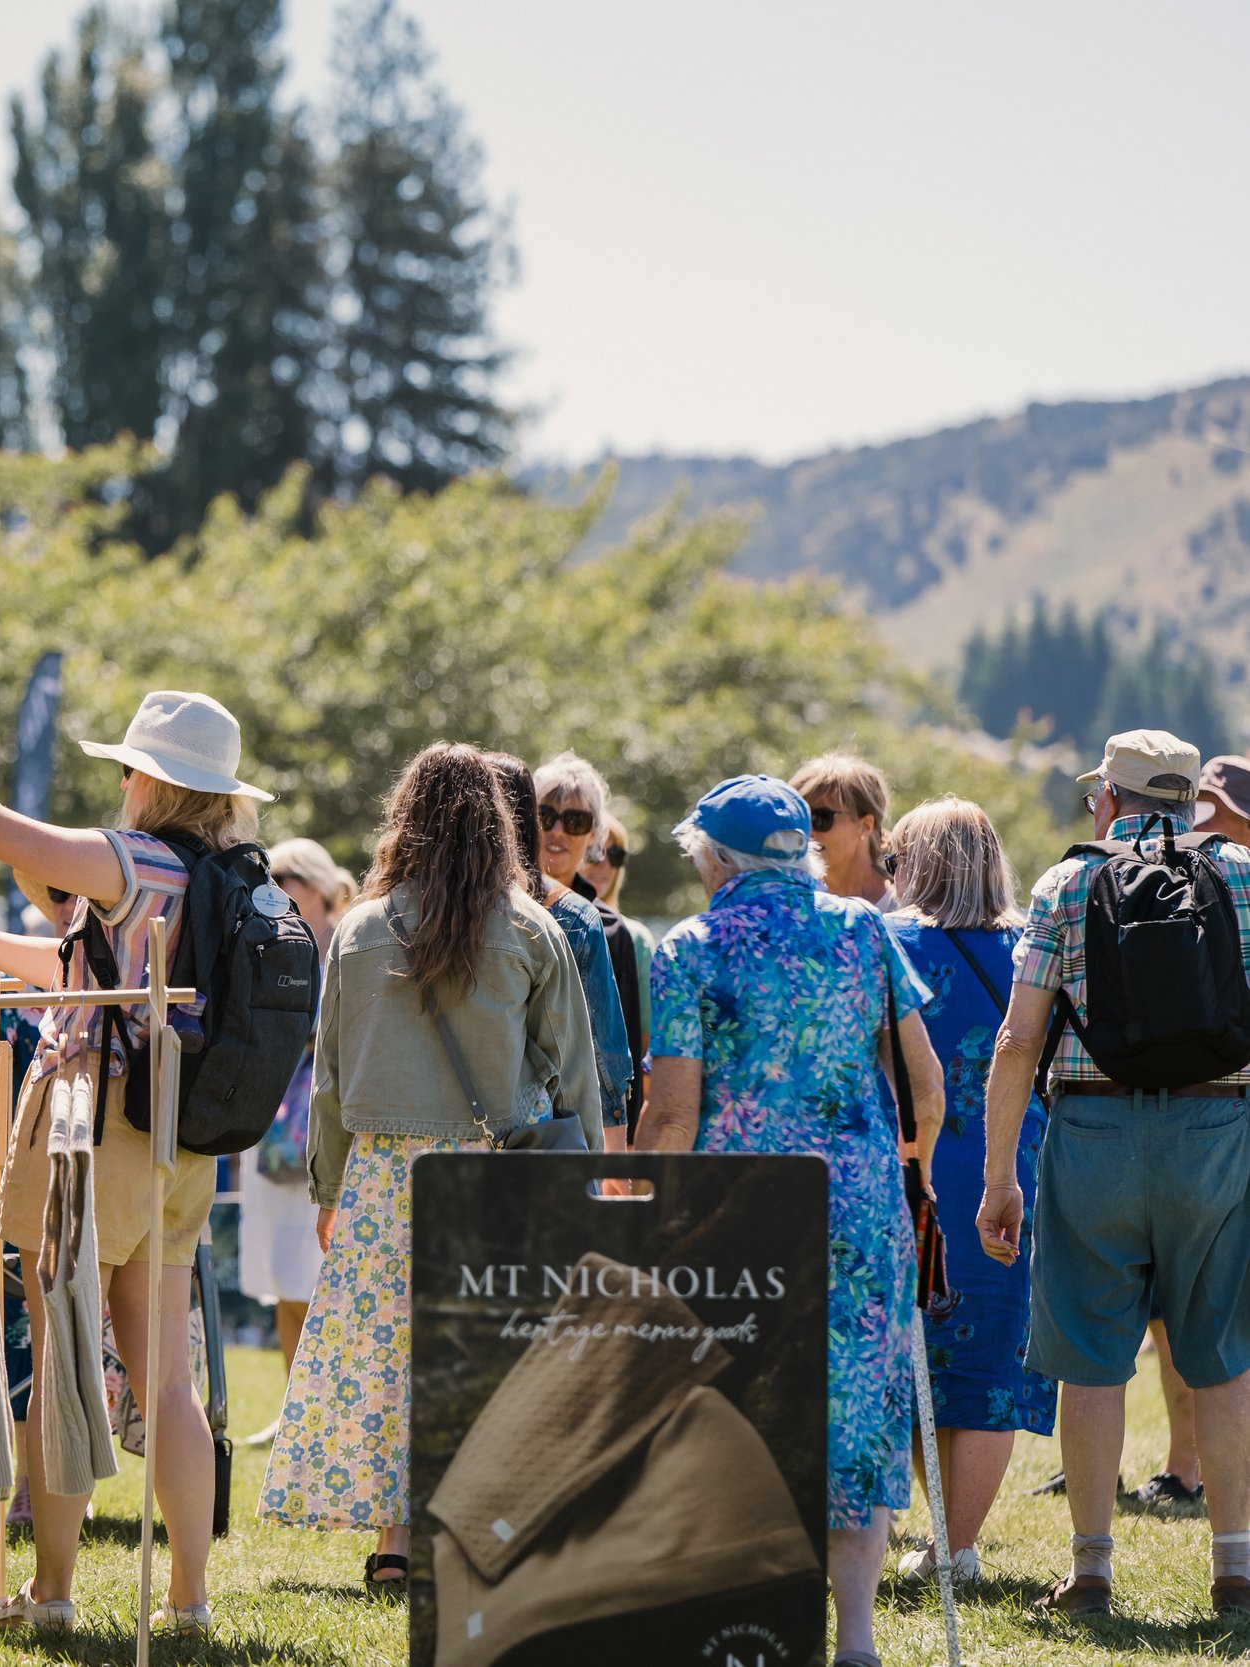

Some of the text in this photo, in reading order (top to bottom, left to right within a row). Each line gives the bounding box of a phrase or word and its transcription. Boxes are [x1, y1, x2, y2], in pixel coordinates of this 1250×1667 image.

[458, 1264, 786, 1300] MT NICHOLAS
[500, 1308, 759, 1363] heritage merino goods
[702, 1623, 790, 1658] MT NICHOLAS
